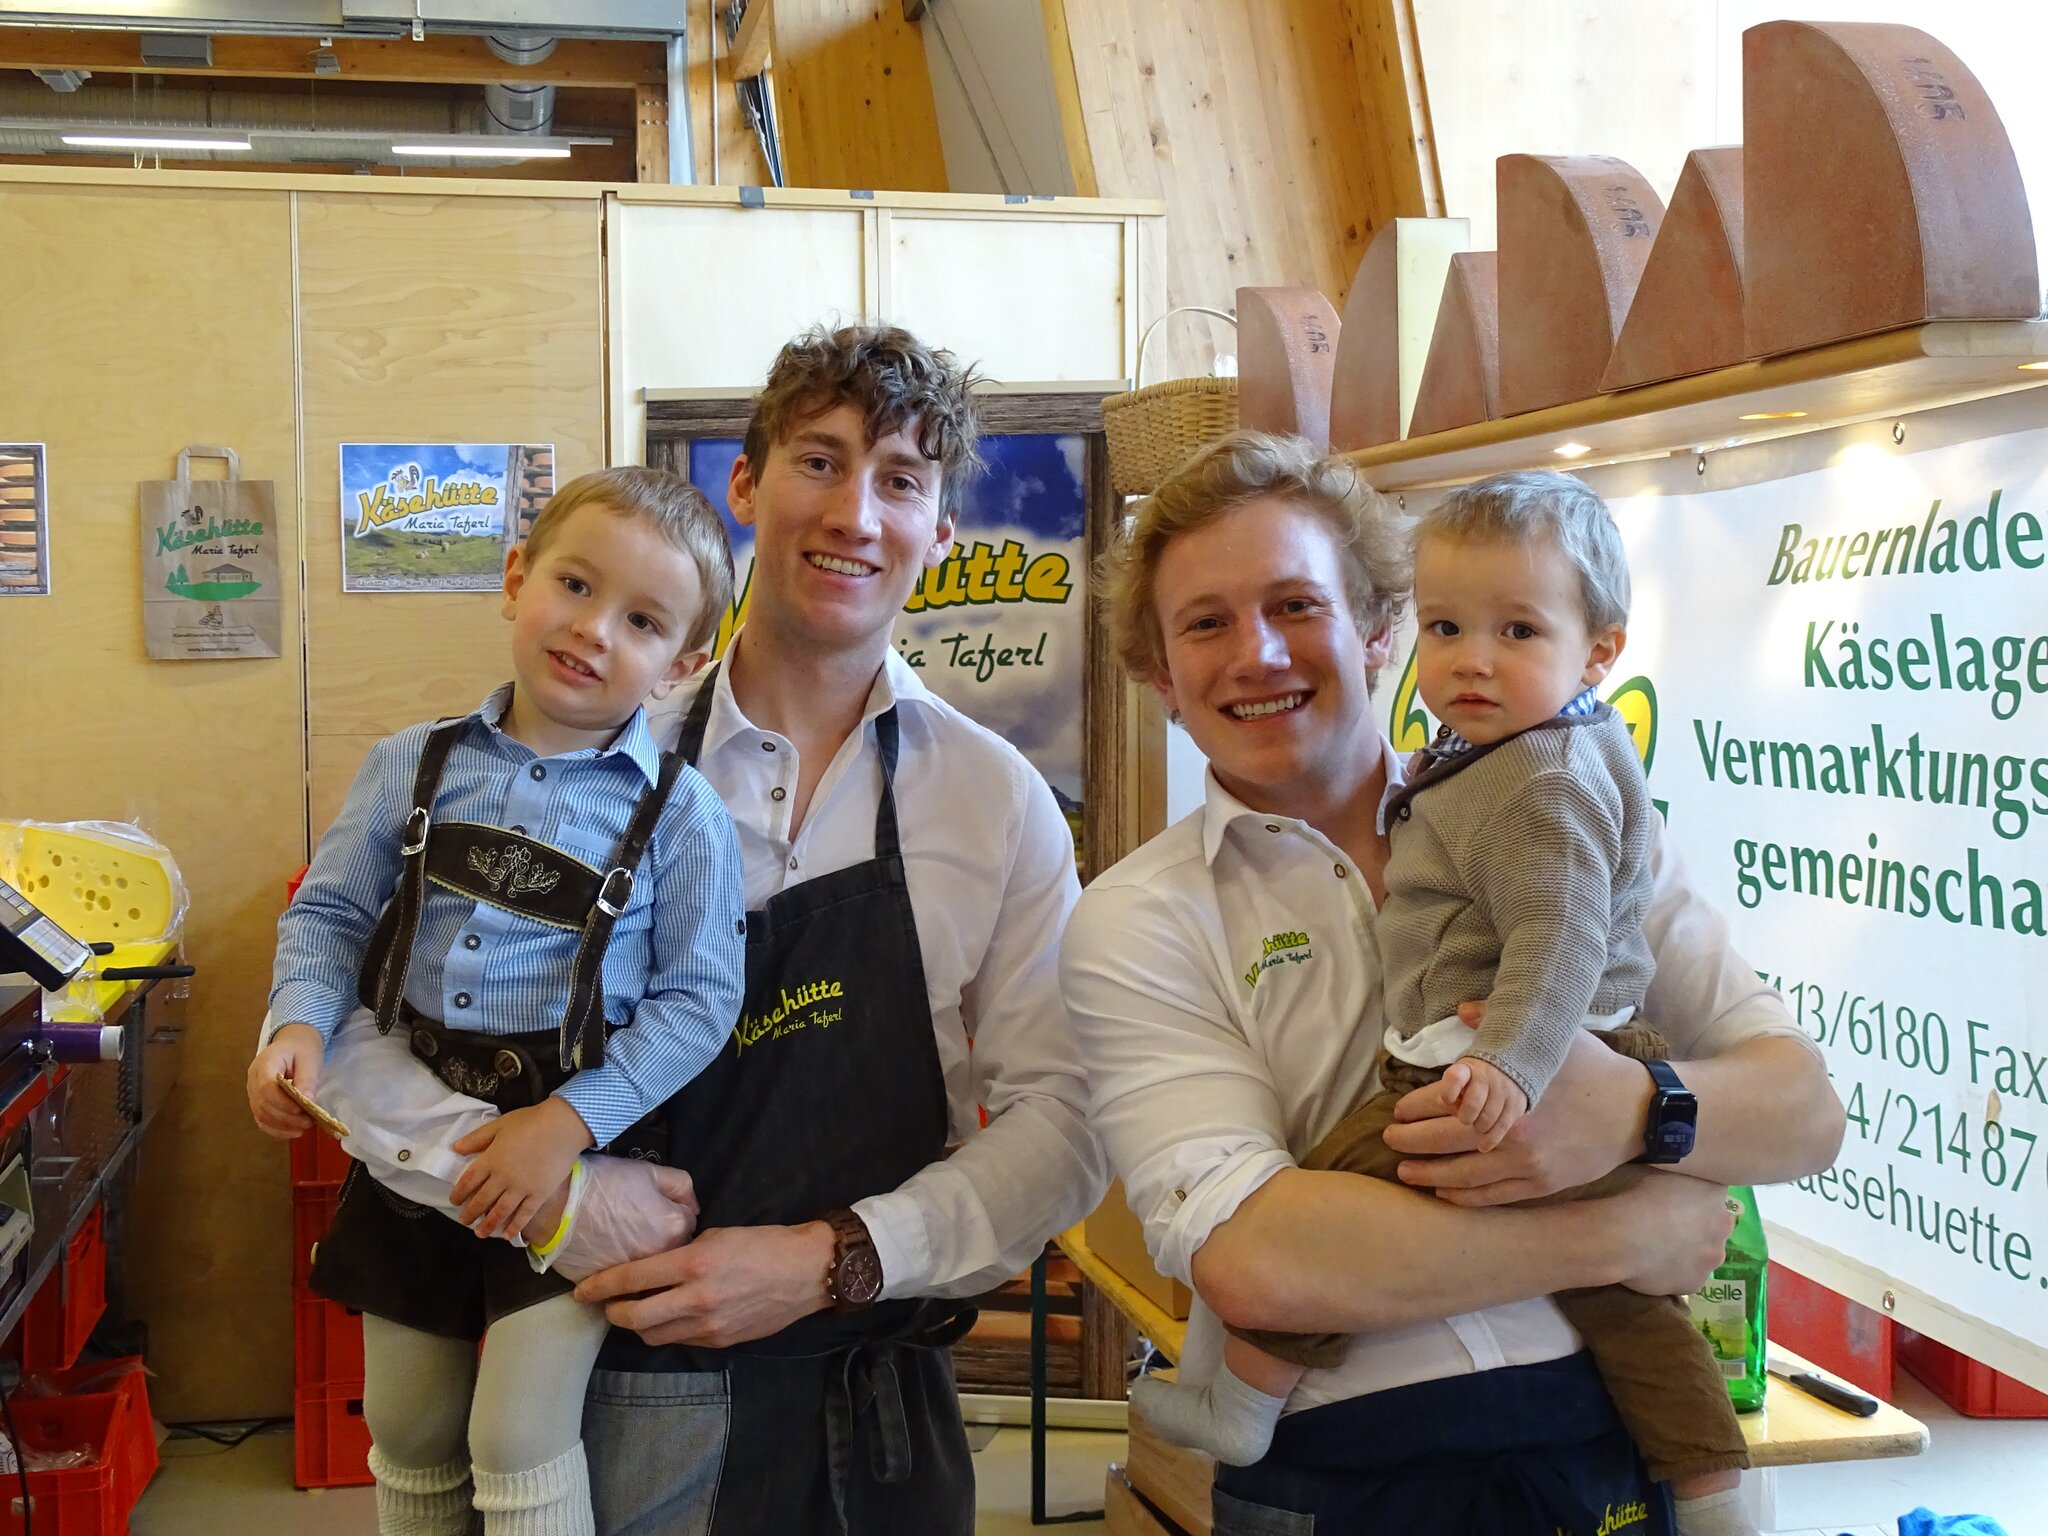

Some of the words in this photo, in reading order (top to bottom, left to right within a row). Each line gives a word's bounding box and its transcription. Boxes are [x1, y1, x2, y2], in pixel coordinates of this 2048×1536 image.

[358, 479, 498, 535] Käsehütte
[404, 517, 445, 530] Maria
[450, 515, 490, 535] Taferl
[156, 516, 263, 557] Käsehütte
[191, 545, 223, 555] Maria
[228, 544, 259, 558] Taferl
[940, 632, 1048, 682] Taferl
[733, 980, 843, 1058] Käsehütte
[772, 1019, 806, 1041] Maria
[809, 1008, 842, 1029] Taferl
[1966, 1019, 2048, 1106] Fax
